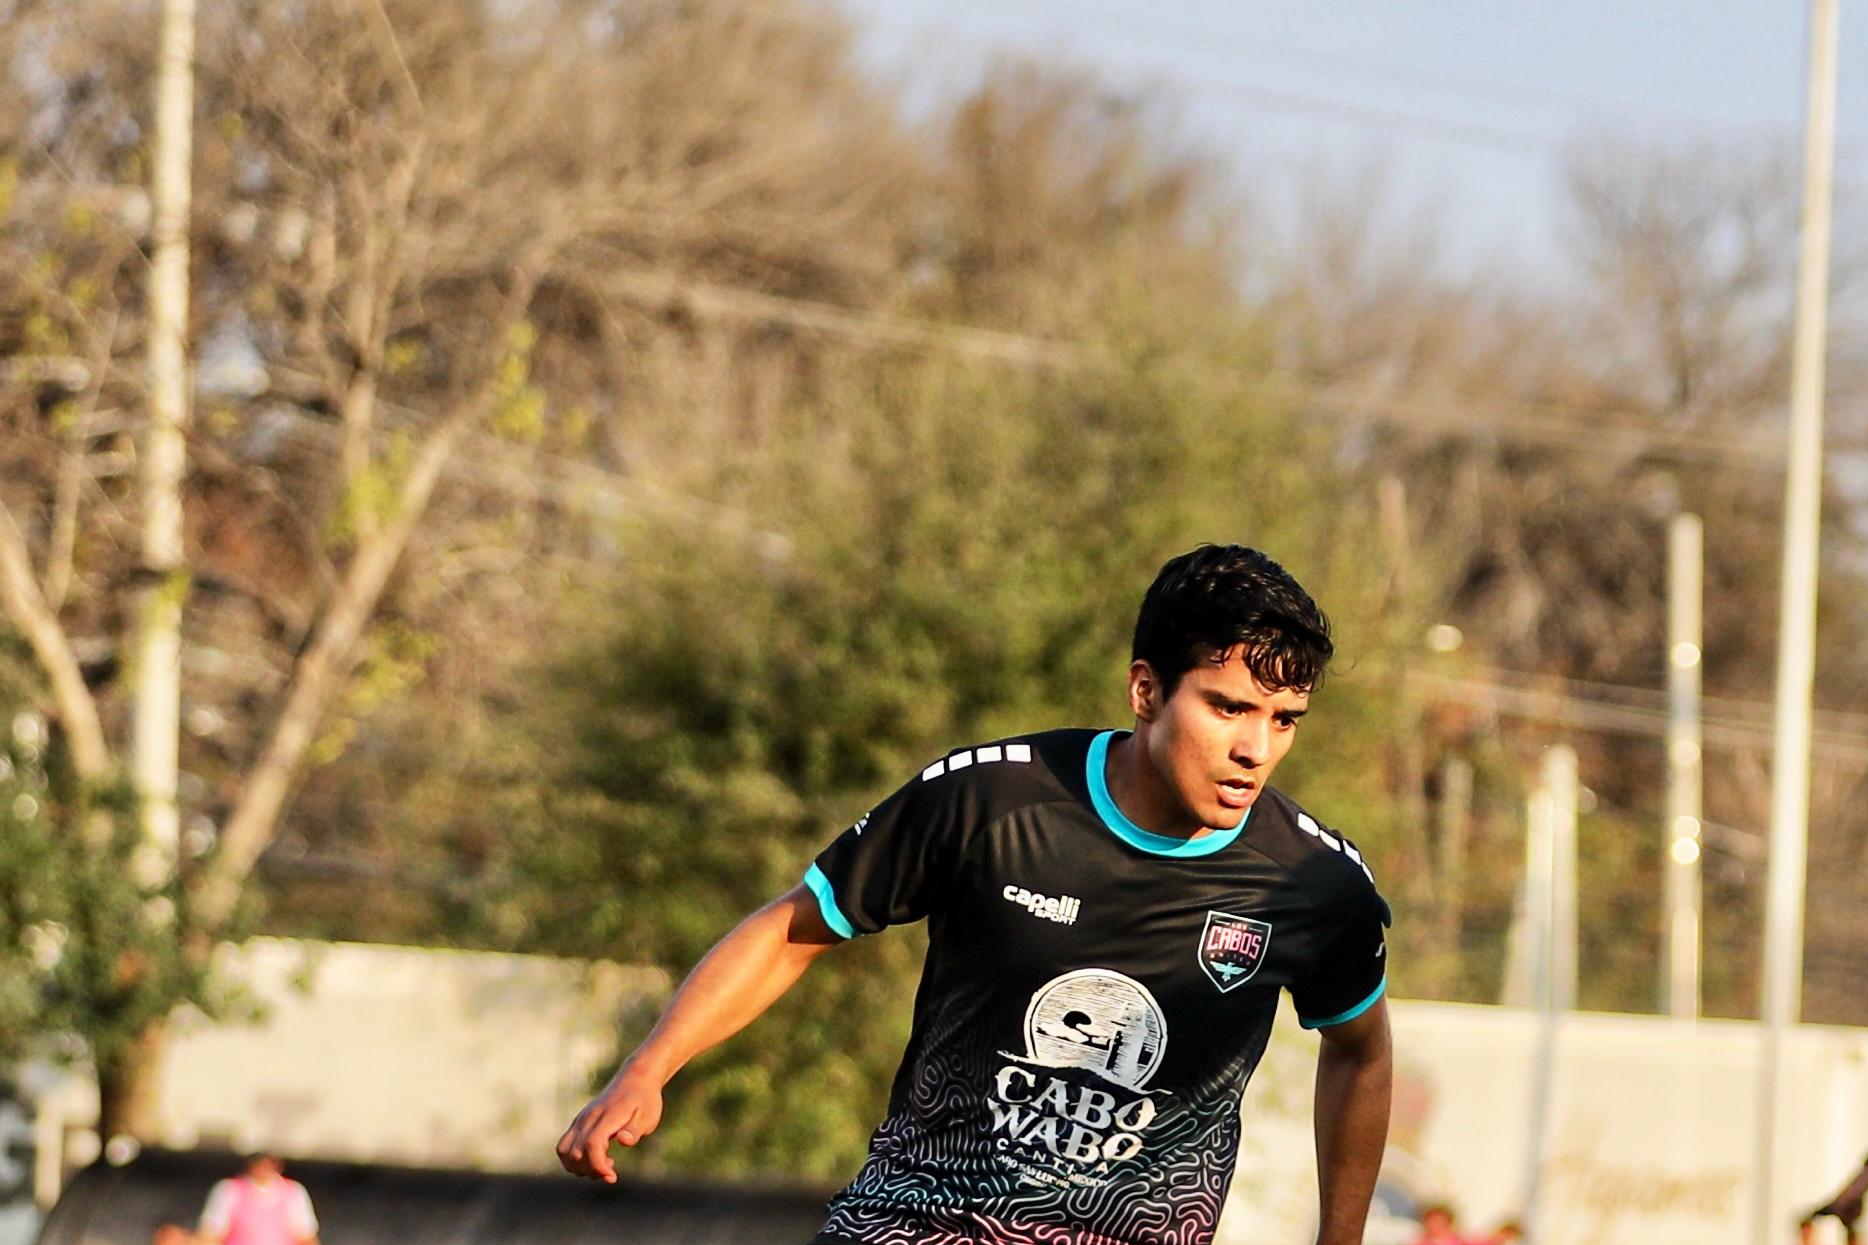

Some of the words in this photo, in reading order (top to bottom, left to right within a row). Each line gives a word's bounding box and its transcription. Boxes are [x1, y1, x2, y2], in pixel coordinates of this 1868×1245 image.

[1003, 885, 1081, 919] capelli
[1034, 909, 1077, 926] SPORT
[1206, 925, 1262, 960] CABOS
[995, 1065, 1158, 1132] CABO
[987, 1097, 1144, 1163] WABO
[996, 1137, 1109, 1175] CANTIA
